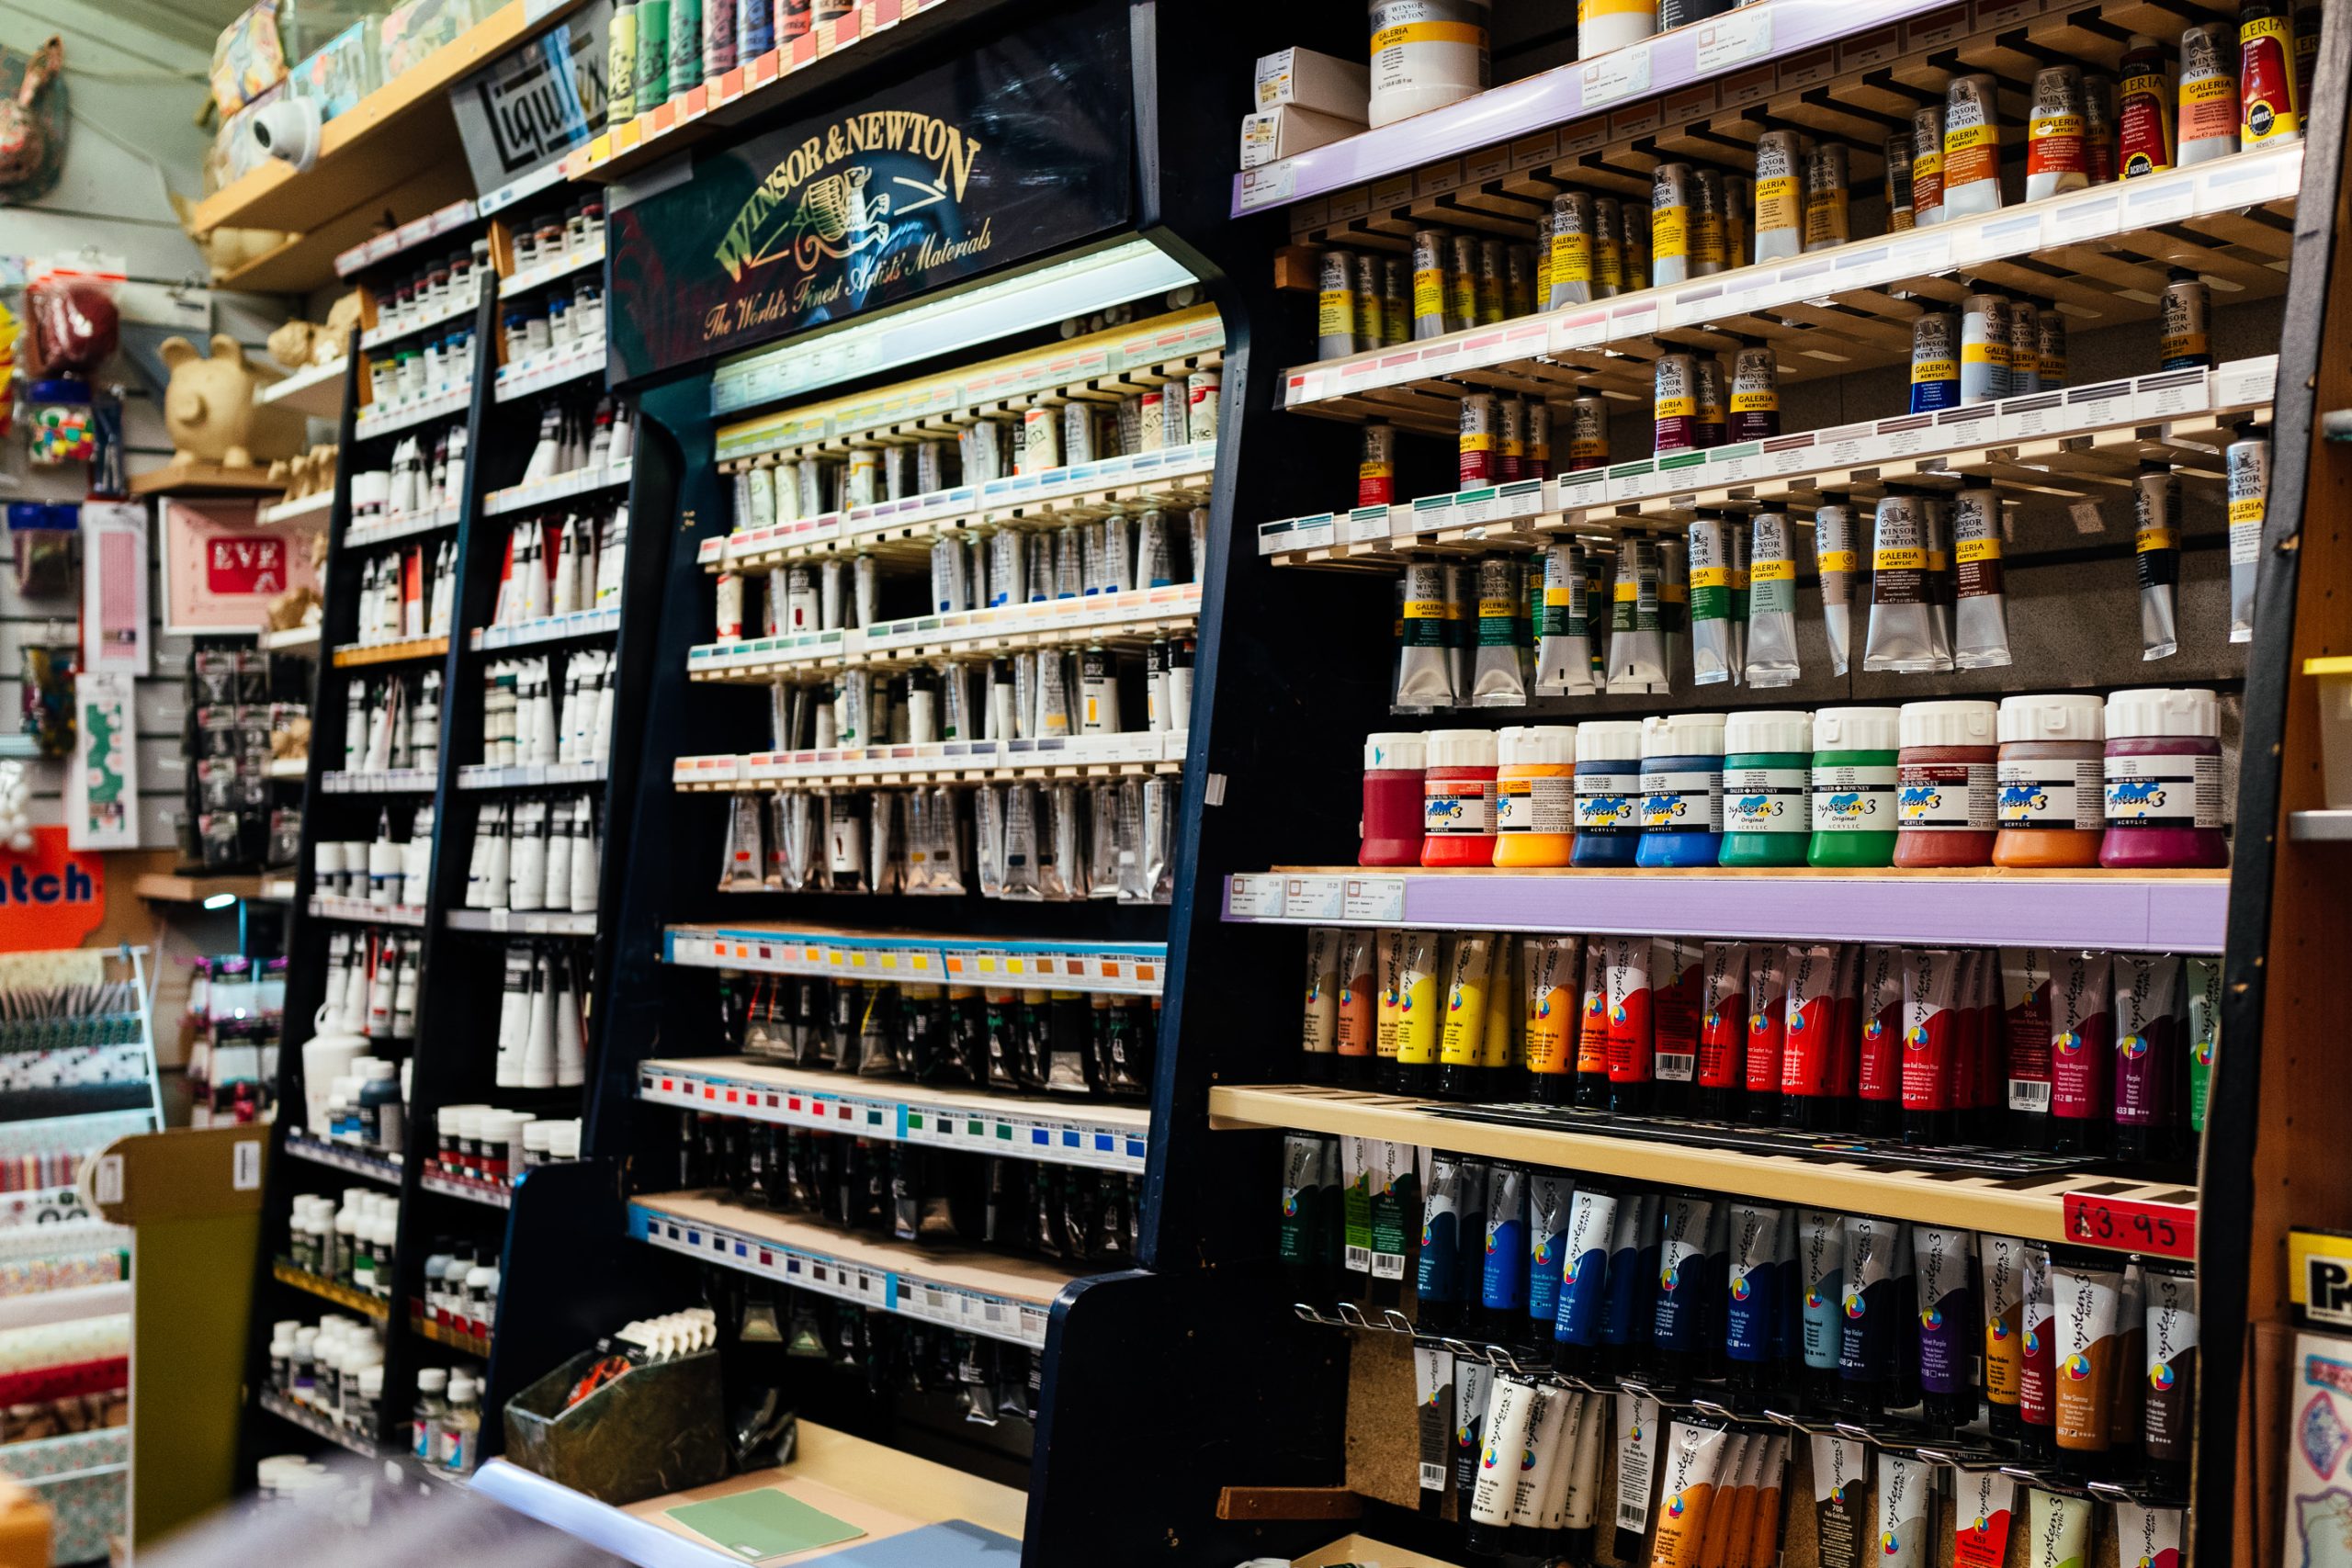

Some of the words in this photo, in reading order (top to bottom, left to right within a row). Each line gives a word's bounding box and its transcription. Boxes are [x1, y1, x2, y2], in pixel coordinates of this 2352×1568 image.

[1391, 1, 1424, 13] WINSOR
[1391, 10, 1424, 22] NEWTON
[1378, 27, 1408, 41] GALERIA
[2189, 65, 2230, 79] NEWTON
[2121, 76, 2164, 93] LERIA
[2189, 80, 2232, 93] GALERIA
[2197, 90, 2225, 98] ACRYLIC
[1946, 106, 1977, 118] WINSOR
[1946, 117, 1979, 129] NEWTON
[2040, 118, 2079, 129] GALERIA
[2252, 110, 2270, 126] ACRYLIC
[1946, 130, 1979, 144] GALERIA
[1951, 139, 1973, 149] ACRYLIC
[2130, 162, 2150, 175] ACRYLIC
[1757, 180, 1786, 191] GALERIA
[715, 136, 825, 283] WINSOR
[845, 110, 981, 203] NEWTON
[1759, 188, 1781, 197] ACRYLIC
[1552, 237, 1581, 245] GALERIA
[704, 304, 731, 341] The
[735, 293, 788, 333] World's
[792, 275, 844, 314] Finest
[906, 218, 991, 276] Materials
[1915, 340, 1951, 349] WINSOR
[1915, 350, 1951, 360] NEWTON
[1984, 345, 2011, 356] GALER
[1915, 363, 1951, 374] GALERIA
[1920, 371, 1946, 379] ACRYLIC
[1739, 382, 1772, 390] NEWTON
[1738, 395, 1773, 403] GALERIA
[2233, 513, 2256, 521] ACRYLIC
[1880, 538, 1918, 547] NEWTON
[213, 542, 279, 570] EVE
[1879, 551, 1918, 559] GALERIA
[1751, 564, 1781, 573] GALERIA
[0, 863, 91, 905] tch
[2126, 1074, 2141, 1083] Purple
[2073, 1201, 2177, 1247] £3.95
[2085, 1289, 2095, 1319] Acrylic
[2073, 1393, 2088, 1403] Sienna
[1630, 1442, 1641, 1450] 006
[1832, 1504, 1844, 1513] 708
[1973, 1535, 1986, 1544] 653
